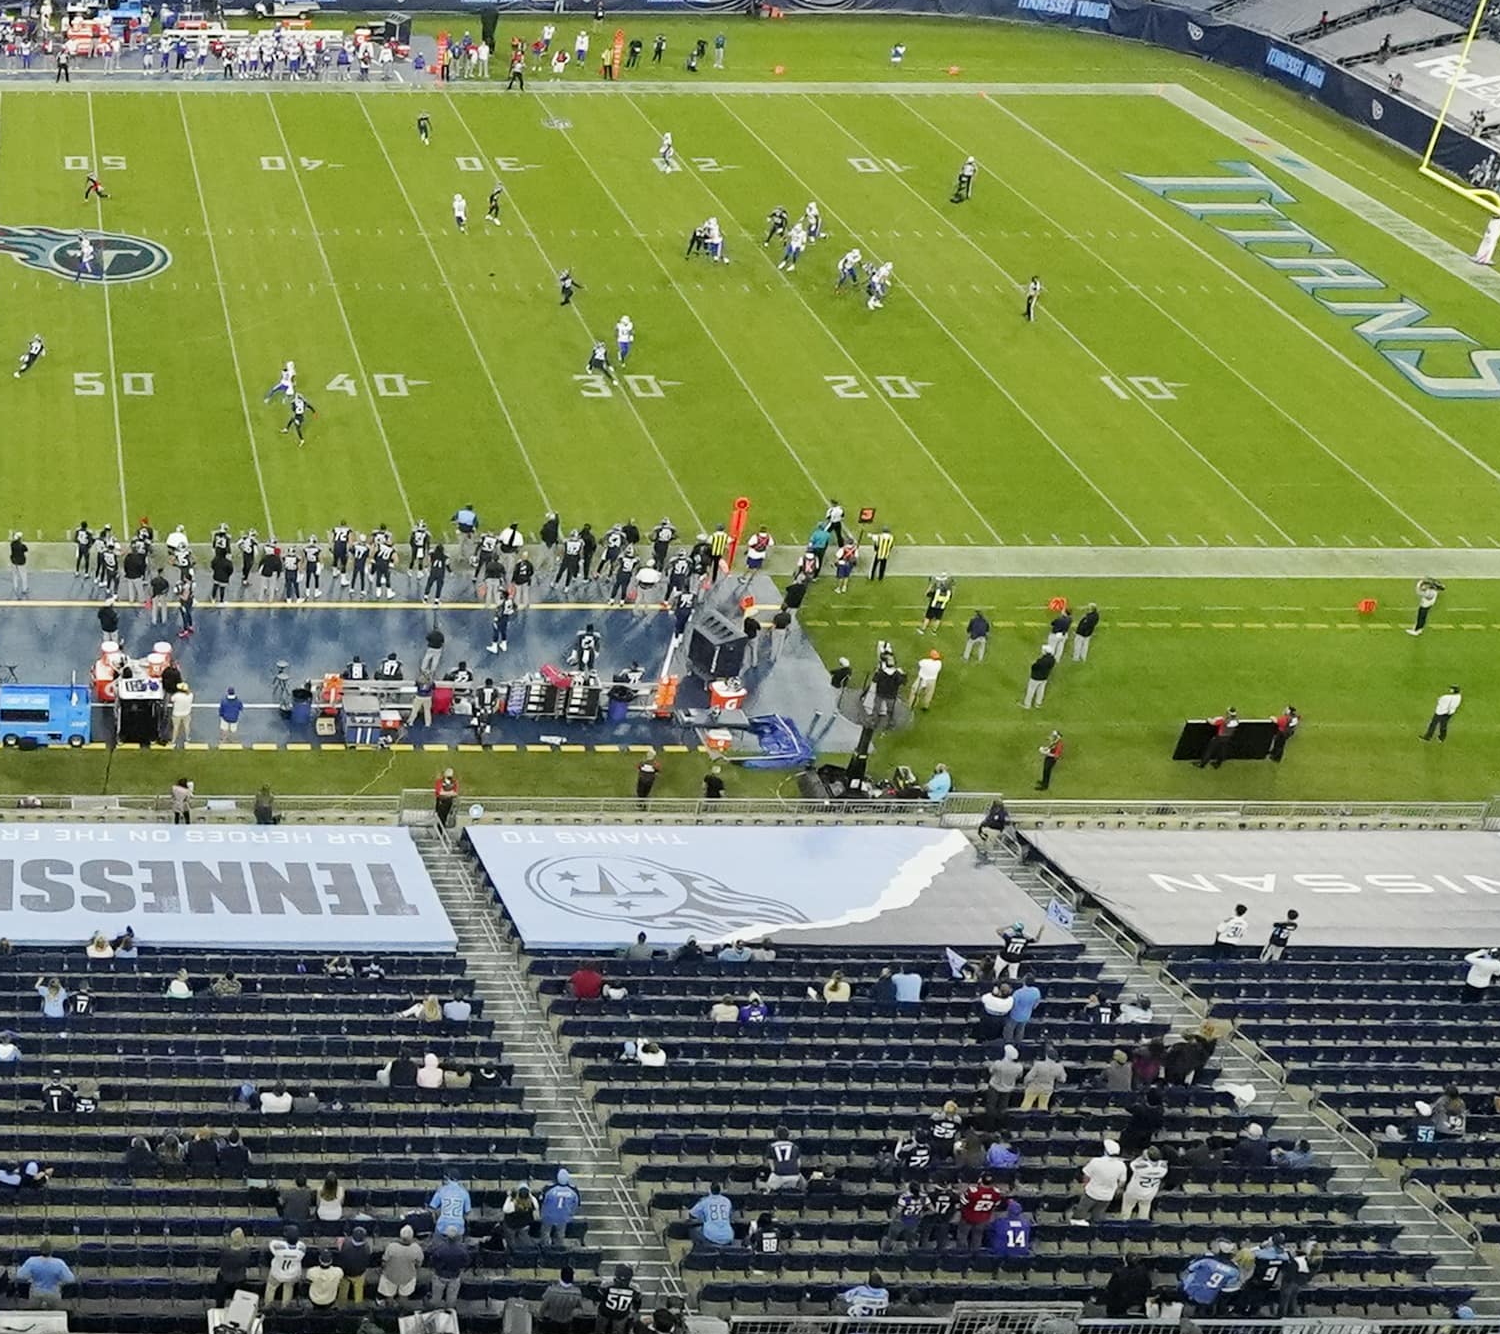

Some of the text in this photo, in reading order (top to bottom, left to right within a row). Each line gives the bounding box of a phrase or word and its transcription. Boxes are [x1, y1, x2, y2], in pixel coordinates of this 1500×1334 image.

[73, 371, 156, 397] 50
[326, 372, 410, 397] 40
[580, 373, 666, 399] 30
[824, 374, 922, 400] 20
[1100, 376, 1178, 401] 10
[53, 829, 116, 844] THE
[127, 830, 172, 845] ON
[186, 830, 316, 846] HEROES
[328, 831, 392, 846] OUR
[500, 831, 689, 847] THANKS TO
[1006, 1230, 1026, 1248] 14
